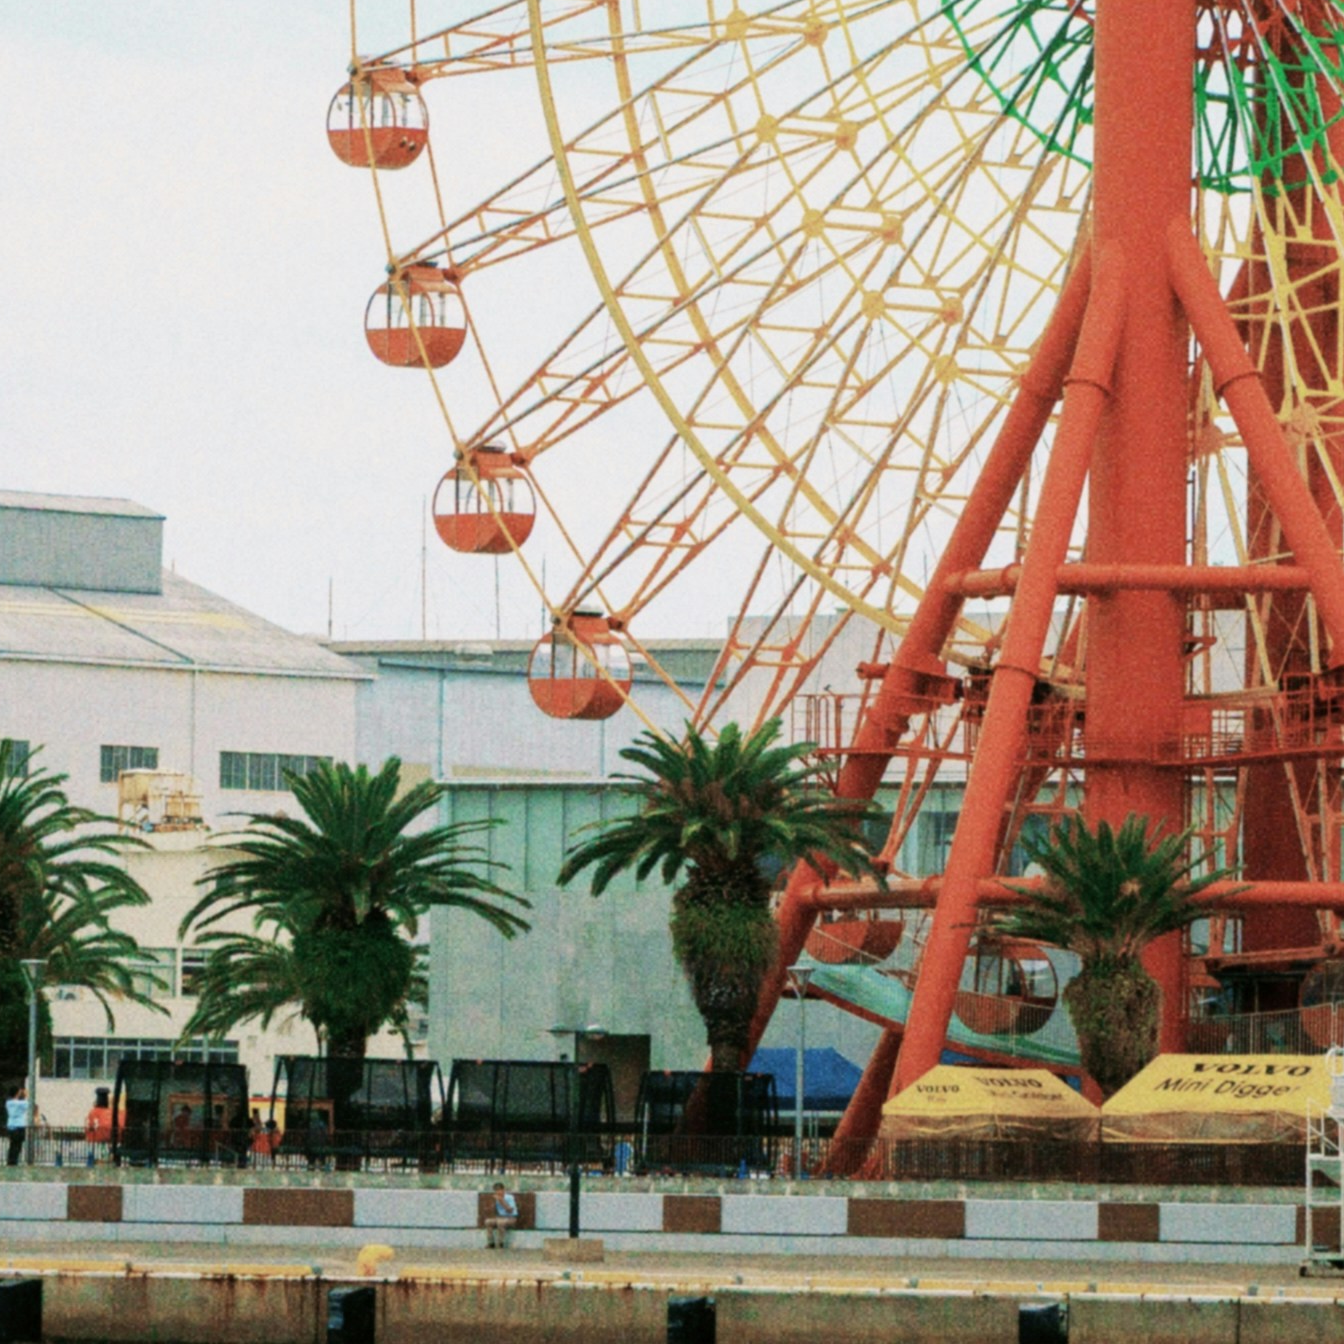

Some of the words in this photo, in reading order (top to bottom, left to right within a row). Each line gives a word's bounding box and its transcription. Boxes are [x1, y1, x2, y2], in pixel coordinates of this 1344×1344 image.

[1194, 1062, 1312, 1077] VOLVO
[916, 1084, 960, 1094] VOLVO
[975, 1076, 1043, 1089] VOLVO
[1154, 1077, 1213, 1093] Mini
[1214, 1079, 1301, 1099] Digger
